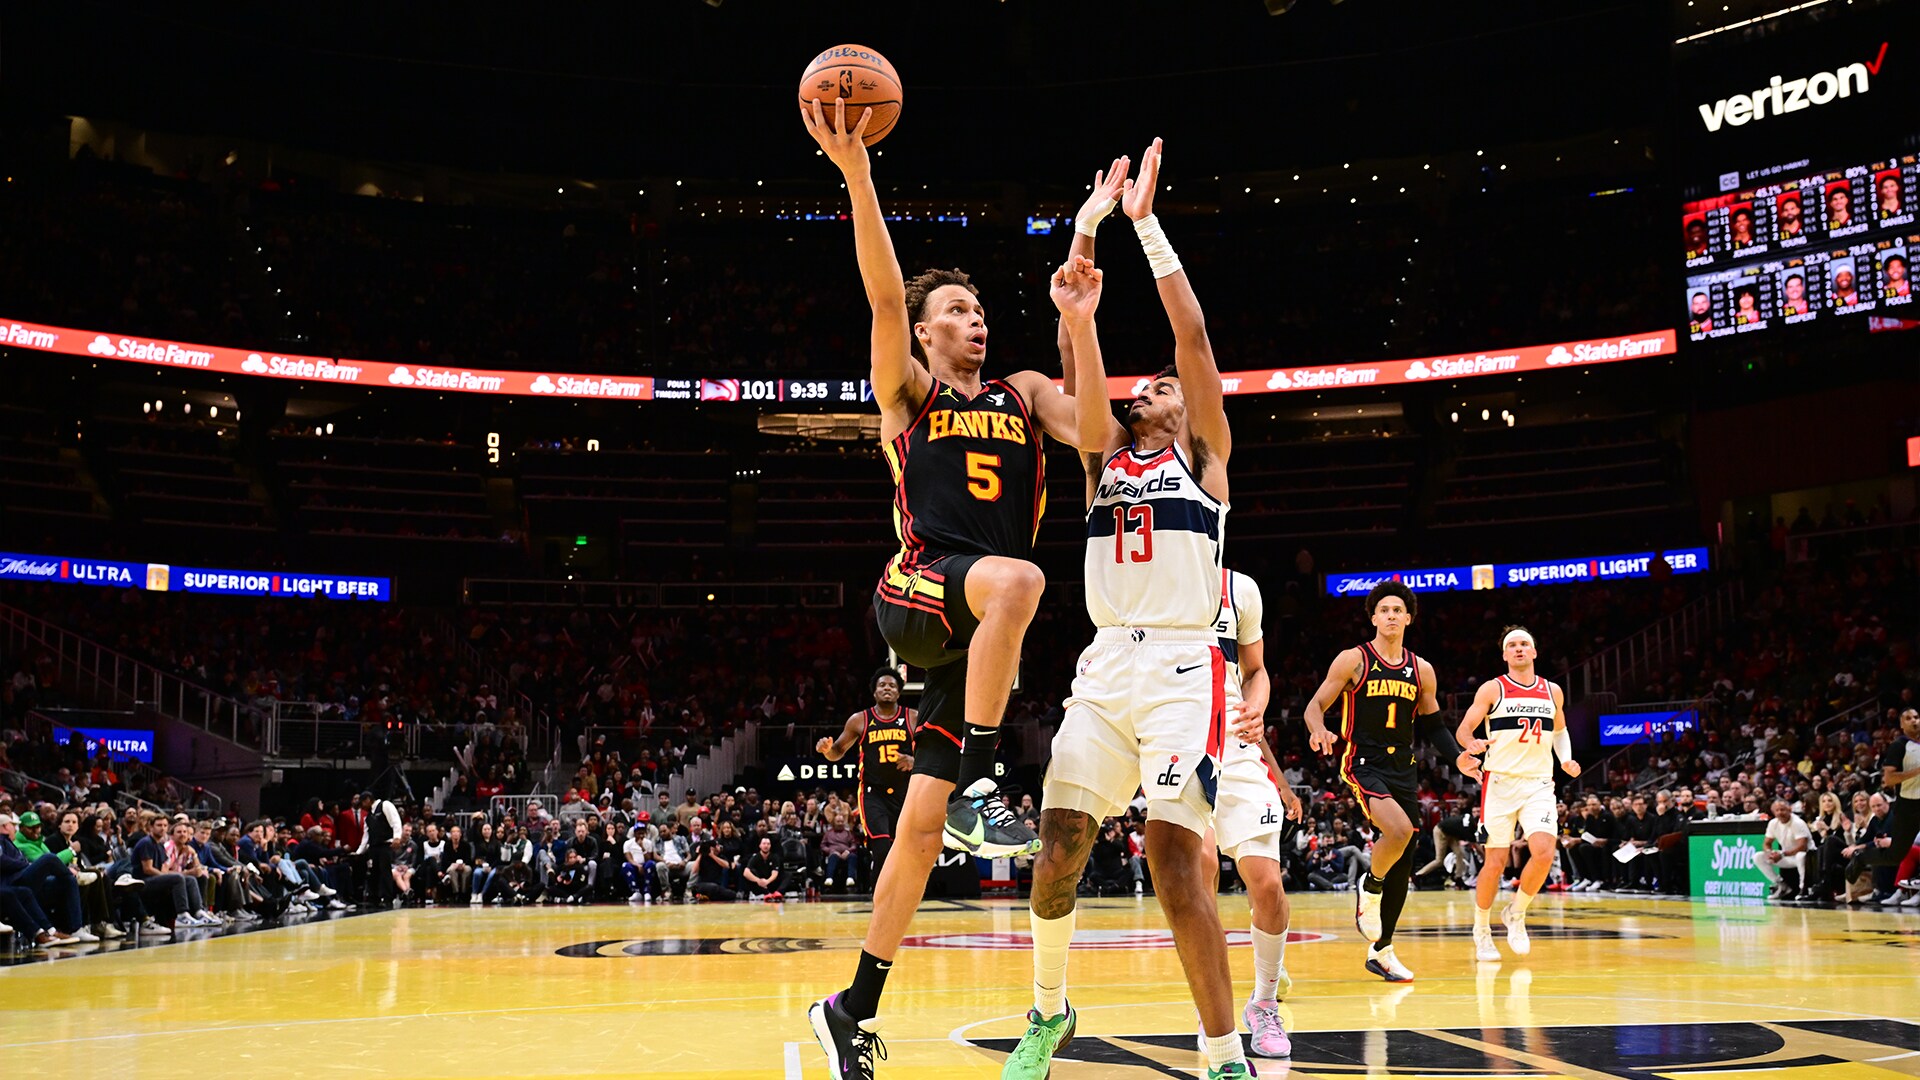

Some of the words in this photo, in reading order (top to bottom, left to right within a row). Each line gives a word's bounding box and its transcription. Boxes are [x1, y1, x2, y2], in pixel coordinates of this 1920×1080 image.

[816, 47, 883, 66] Wilson
[1698, 62, 1869, 132] verizon
[1722, 176, 1737, 187] CC
[655, 389, 691, 399] TIMEOUTS
[667, 380, 691, 389] FOULS
[741, 380, 776, 400] 101
[789, 382, 828, 399] 9:35
[841, 381, 855, 391] 21
[840, 391, 857, 401] 4TH
[928, 409, 1027, 446] HAWKS
[965, 450, 1002, 503] 5
[1095, 470, 1183, 500] wizards
[1113, 503, 1154, 565] 13
[72, 563, 132, 583] ULTRA
[1508, 562, 1587, 583] SUPERIOR
[1600, 557, 1650, 576] LIGHT
[1664, 553, 1697, 569] EER
[183, 572, 270, 592] SUPERIOR
[283, 577, 333, 595] LIGHT
[337, 581, 379, 597] BEER
[1403, 573, 1459, 589] ULTRA
[1366, 679, 1418, 702] HAWKS
[1385, 702, 1397, 729] 1
[1506, 703, 1551, 715] wizards
[868, 729, 907, 744] HAWKS
[1517, 717, 1542, 745] 24
[878, 744, 900, 764] 15
[800, 763, 859, 780] DELT
[1260, 808, 1278, 825] dc
[1711, 837, 1756, 877] Sprite
[1740, 882, 1765, 896] THIRST
